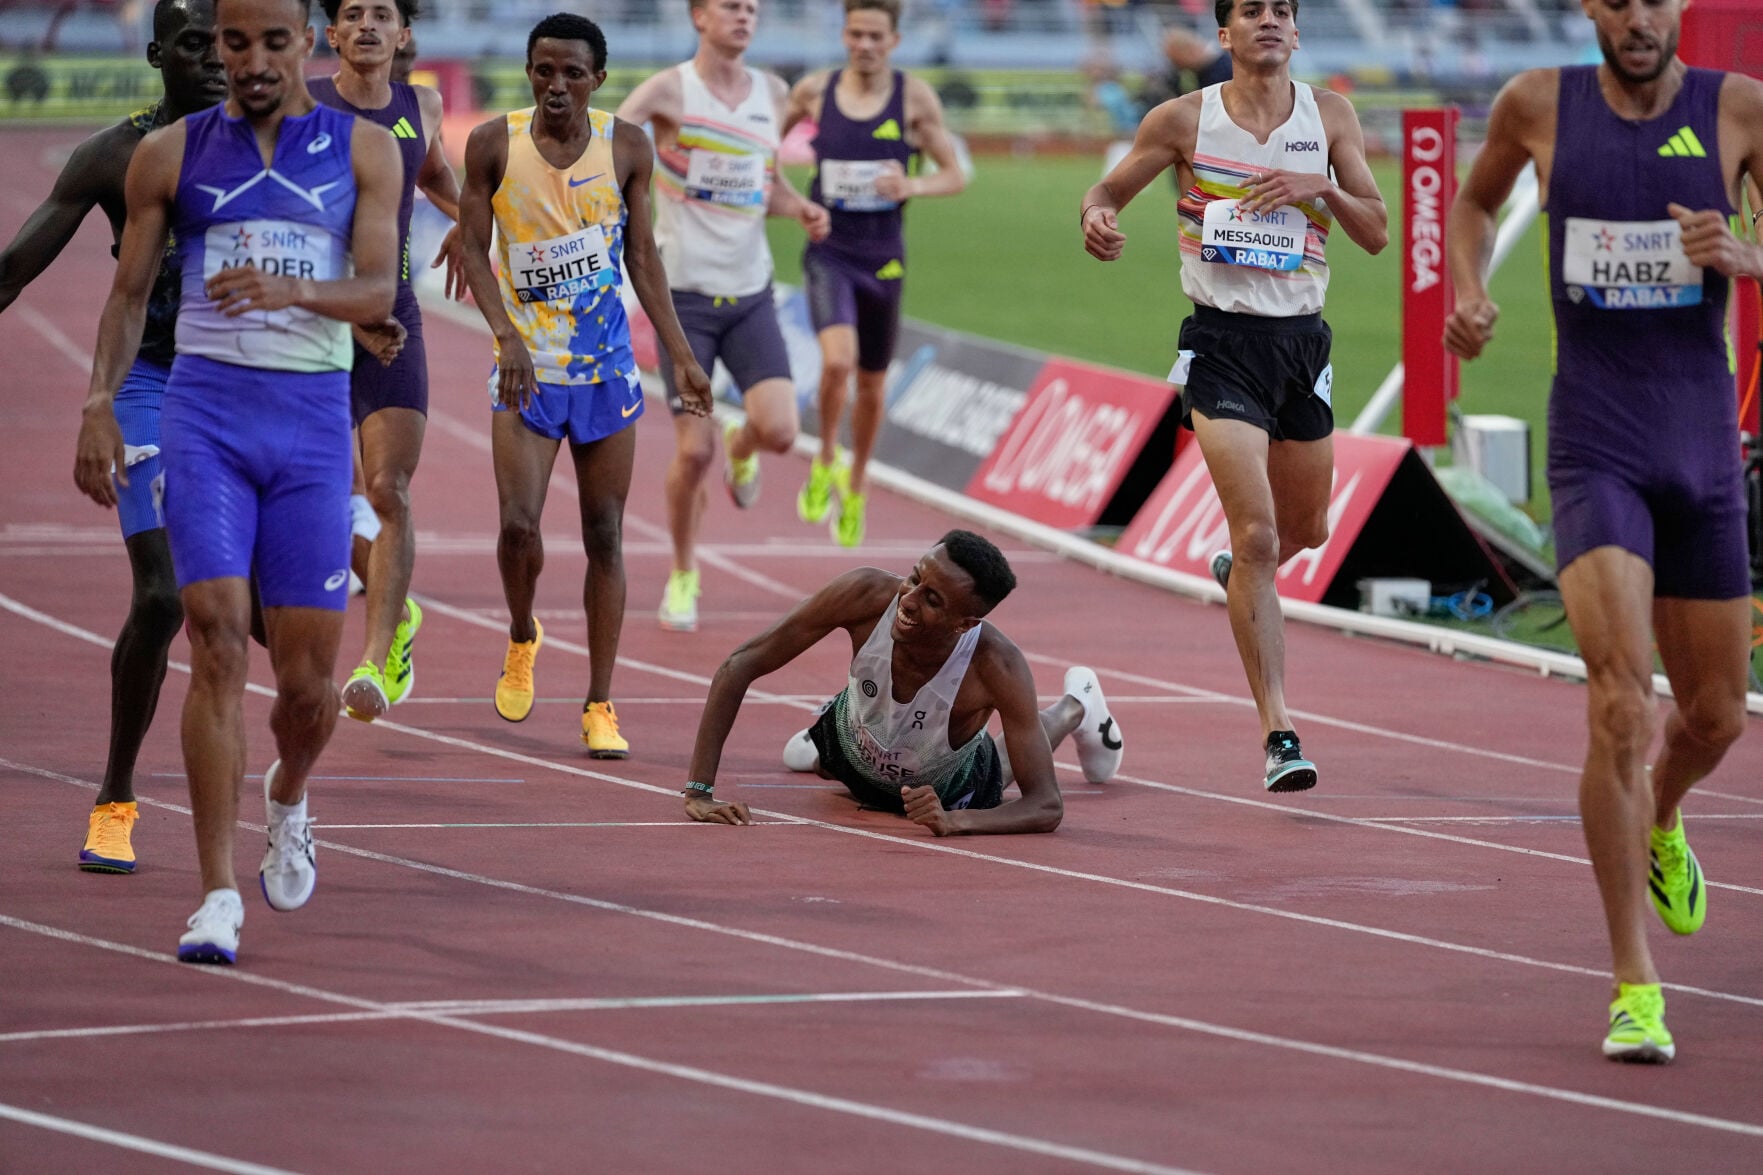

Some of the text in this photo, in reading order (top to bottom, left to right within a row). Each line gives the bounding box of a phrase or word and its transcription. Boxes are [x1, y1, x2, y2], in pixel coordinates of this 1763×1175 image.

[1284, 141, 1320, 153] HOKA
[1250, 208, 1289, 226] SNRT
[261, 230, 307, 249] SNRT
[1213, 229, 1295, 249] MESSAOUDI
[1411, 166, 1442, 293] OMEGA
[550, 237, 586, 259] SNRT
[1623, 231, 1673, 252] SNRT
[520, 253, 601, 287] TSHITE
[1234, 249, 1290, 270] RABAT
[1592, 260, 1672, 283] HABZ
[545, 273, 601, 301] RABAT
[1604, 286, 1684, 310] RABAT
[1216, 400, 1246, 413] HOKA
